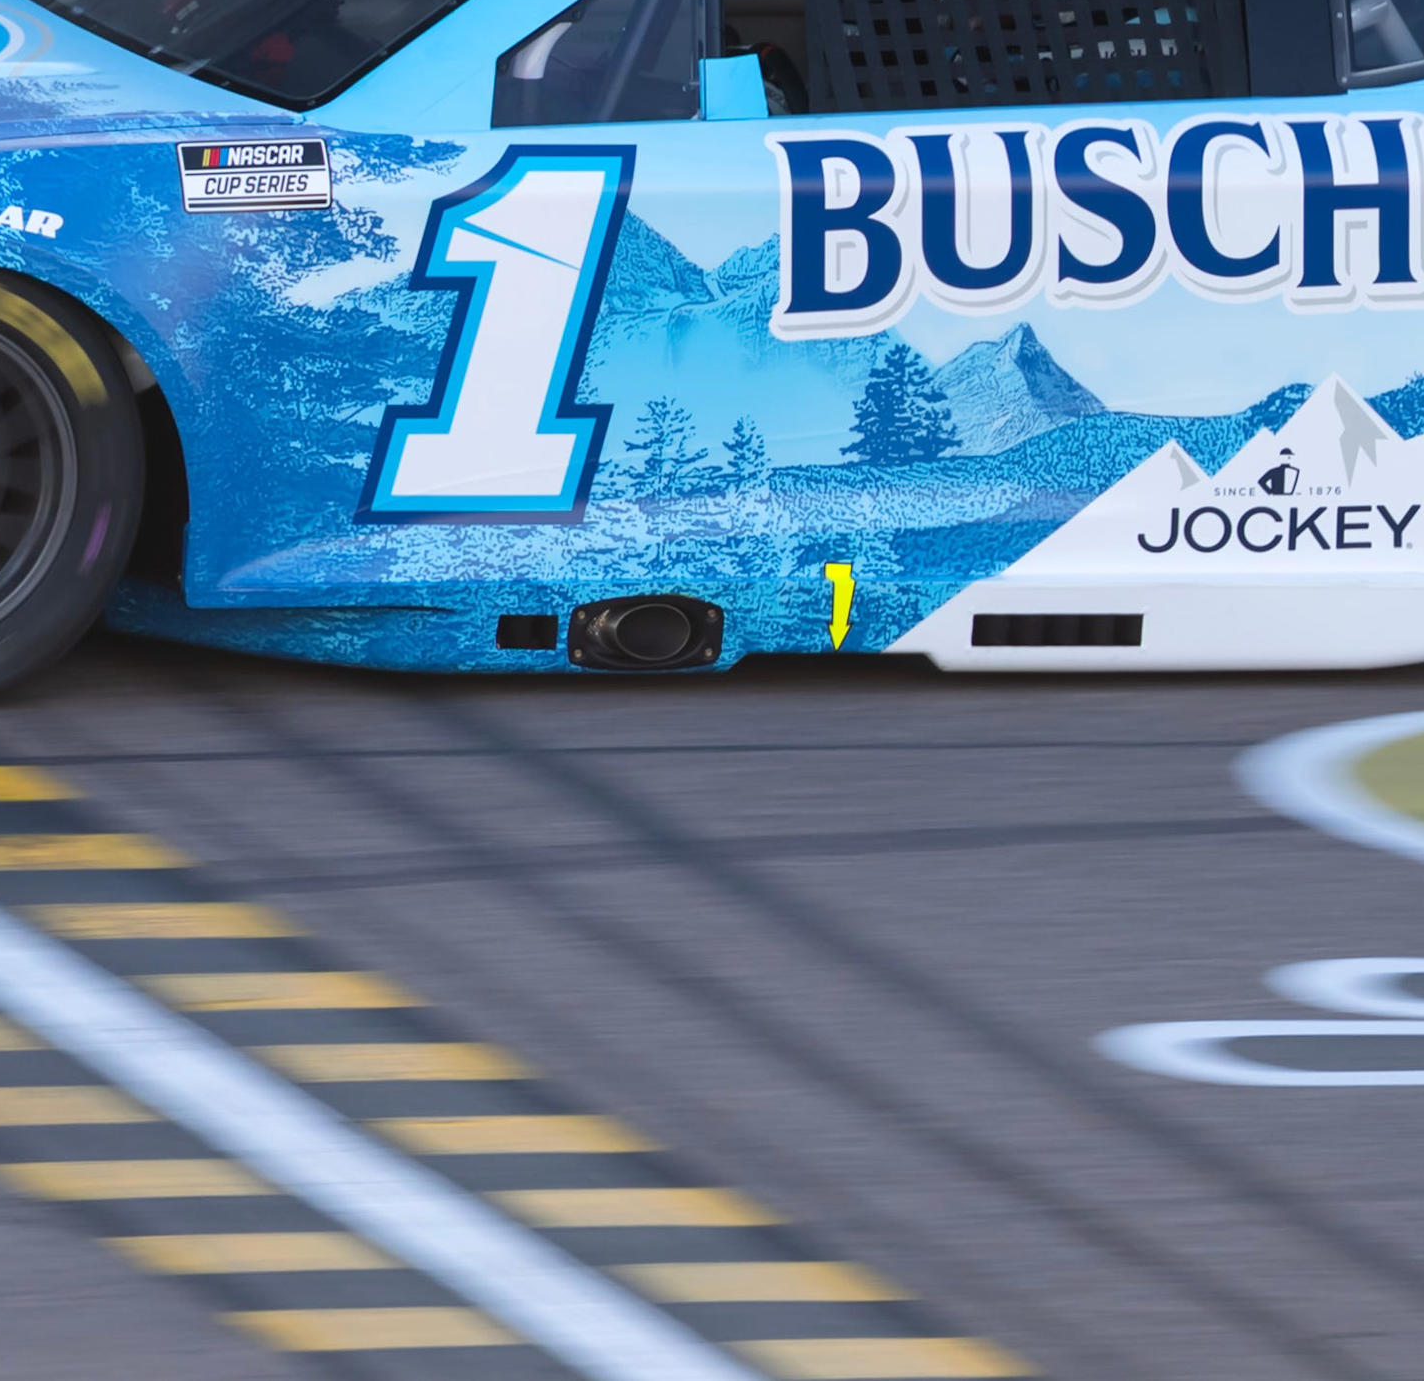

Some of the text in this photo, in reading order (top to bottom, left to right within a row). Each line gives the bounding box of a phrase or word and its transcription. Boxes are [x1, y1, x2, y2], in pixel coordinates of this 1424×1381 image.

[227, 144, 305, 167] NASCAR
[204, 174, 309, 195] CUP SERIES
[361, 149, 630, 519] 1
[1213, 486, 1343, 497] SINCE 1876
[1137, 504, 1421, 554] JOCKEY
